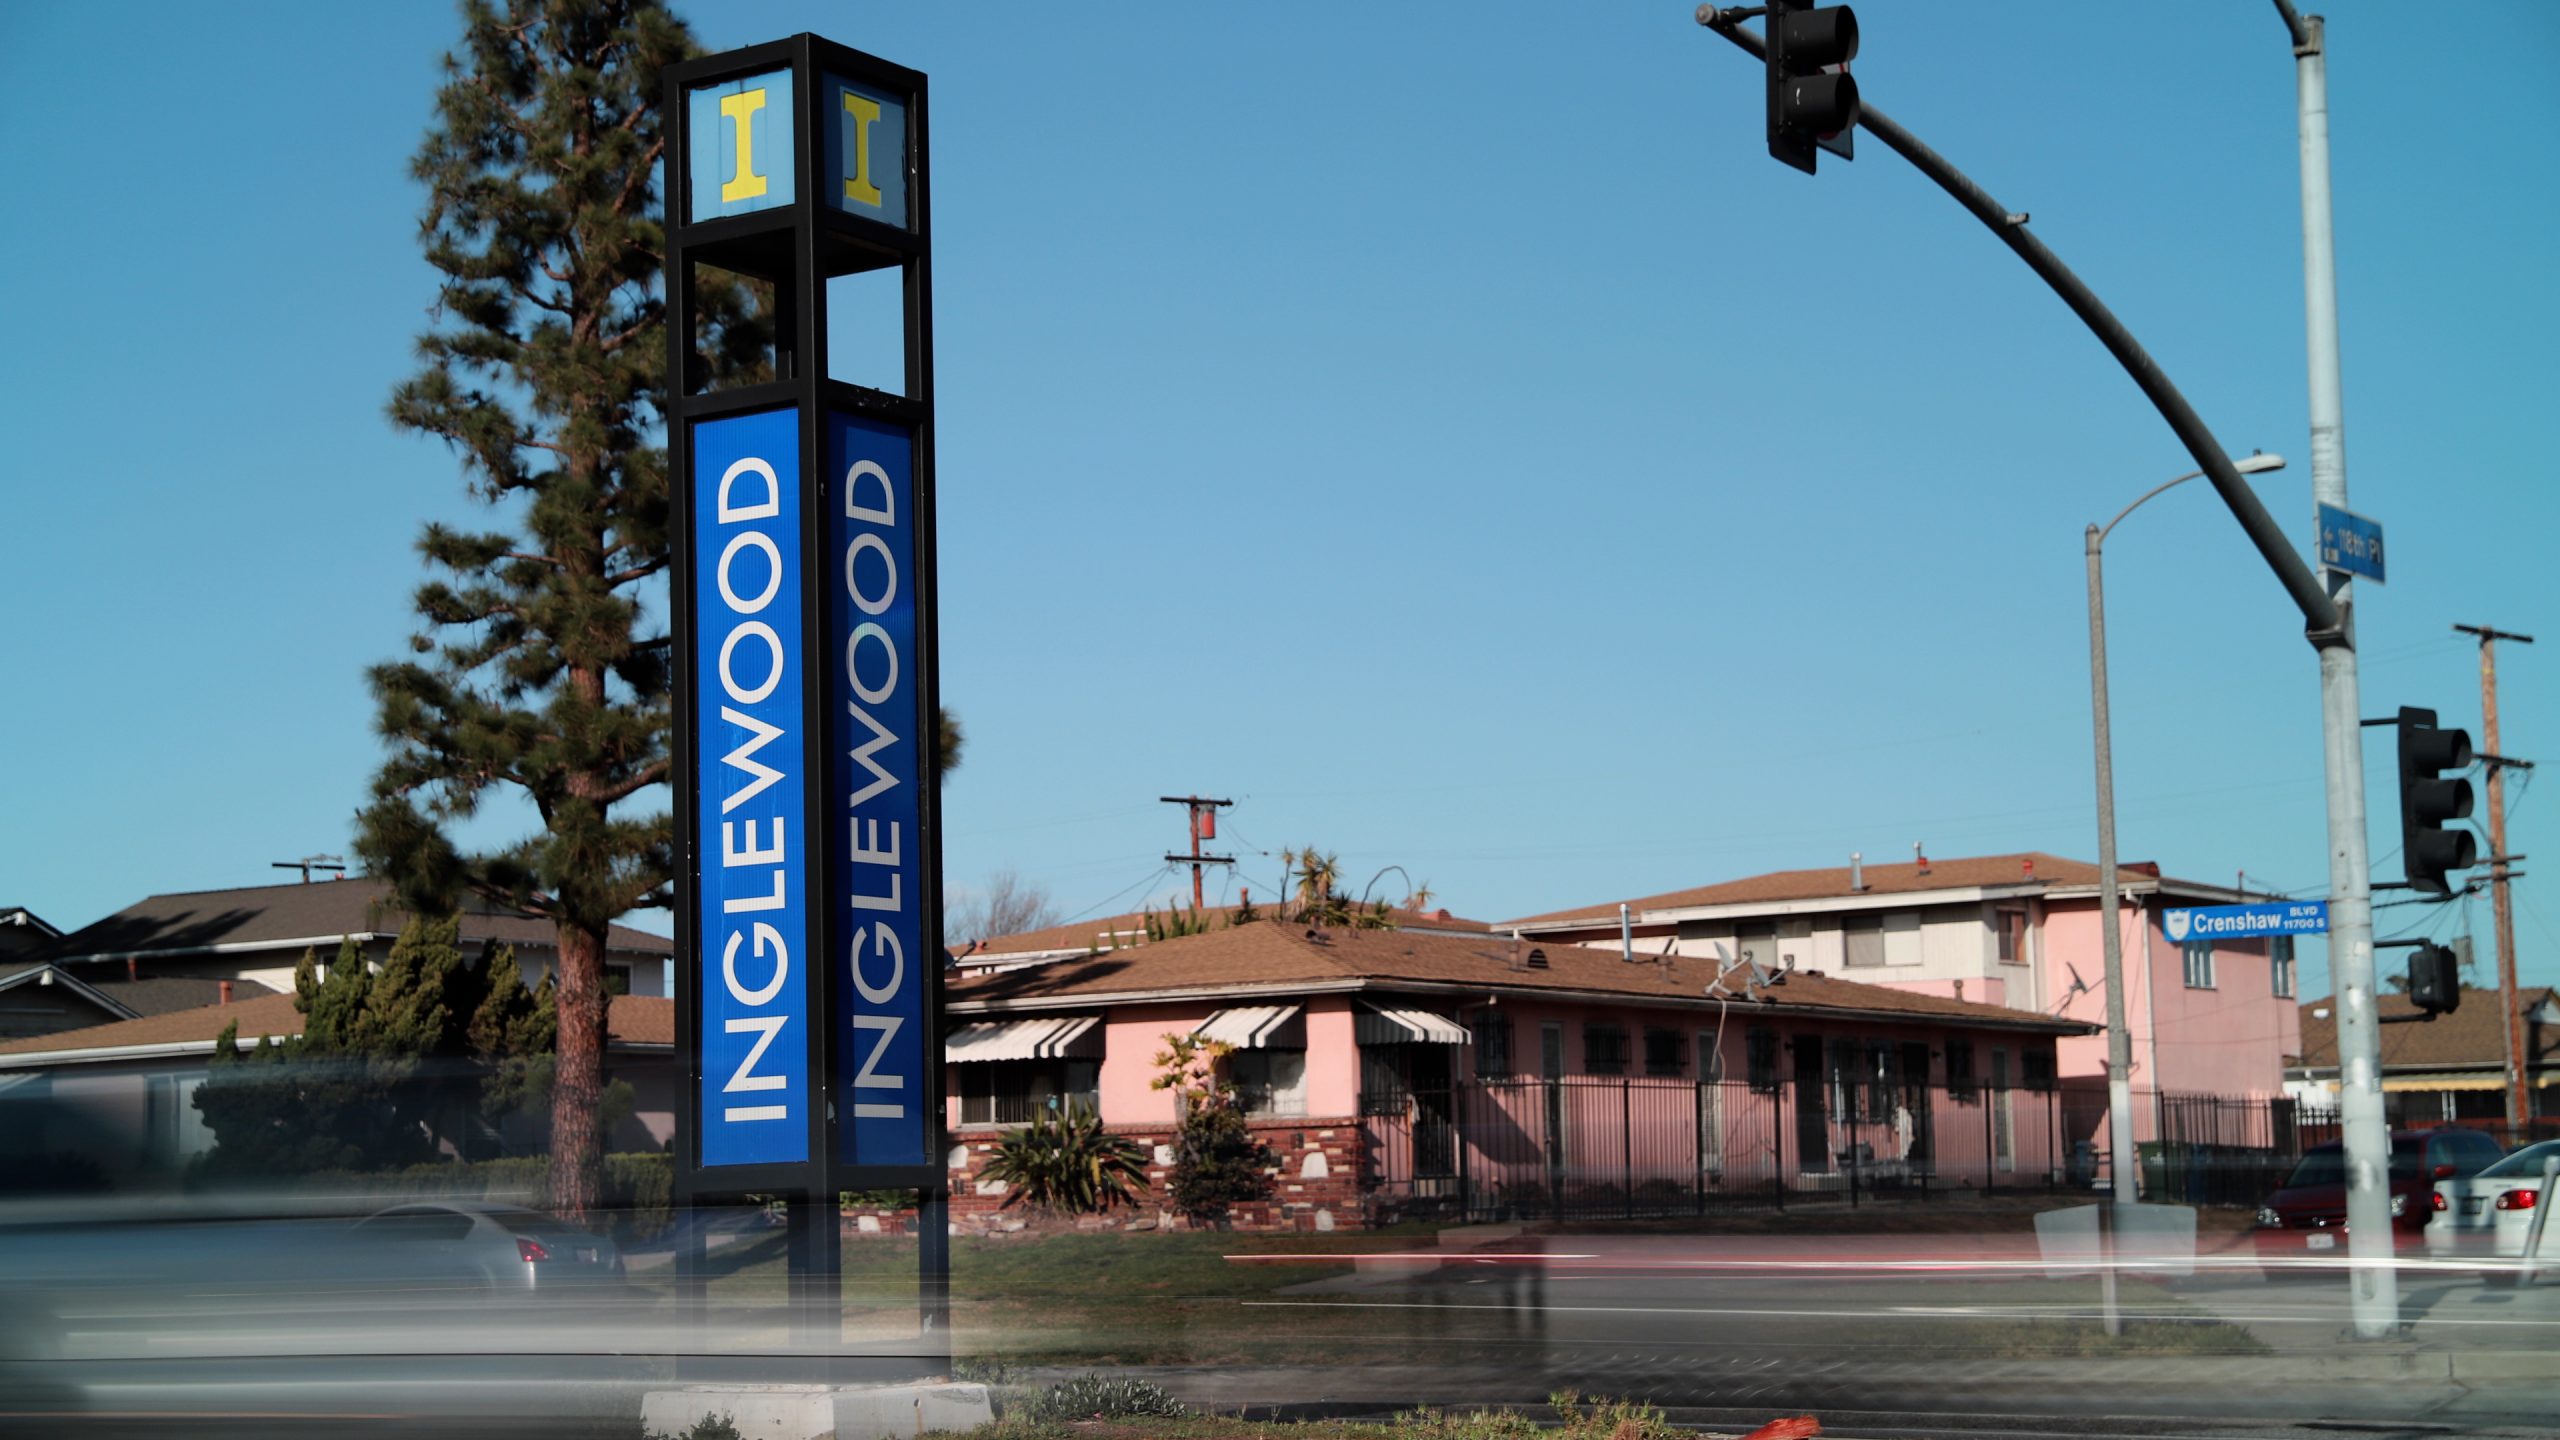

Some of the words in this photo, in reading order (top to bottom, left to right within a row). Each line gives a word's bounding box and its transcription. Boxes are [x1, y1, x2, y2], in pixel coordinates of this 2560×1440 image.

[720, 88, 767, 203] I
[843, 91, 882, 208] I
[717, 457, 789, 1122] INGLEWOOD
[845, 460, 905, 1119] INGLEWOOD
[2193, 912, 2281, 933] Crenshaw
[2290, 905, 2318, 917] BLVD
[2284, 917, 2315, 929] 11700
[2316, 917, 2325, 928] S
